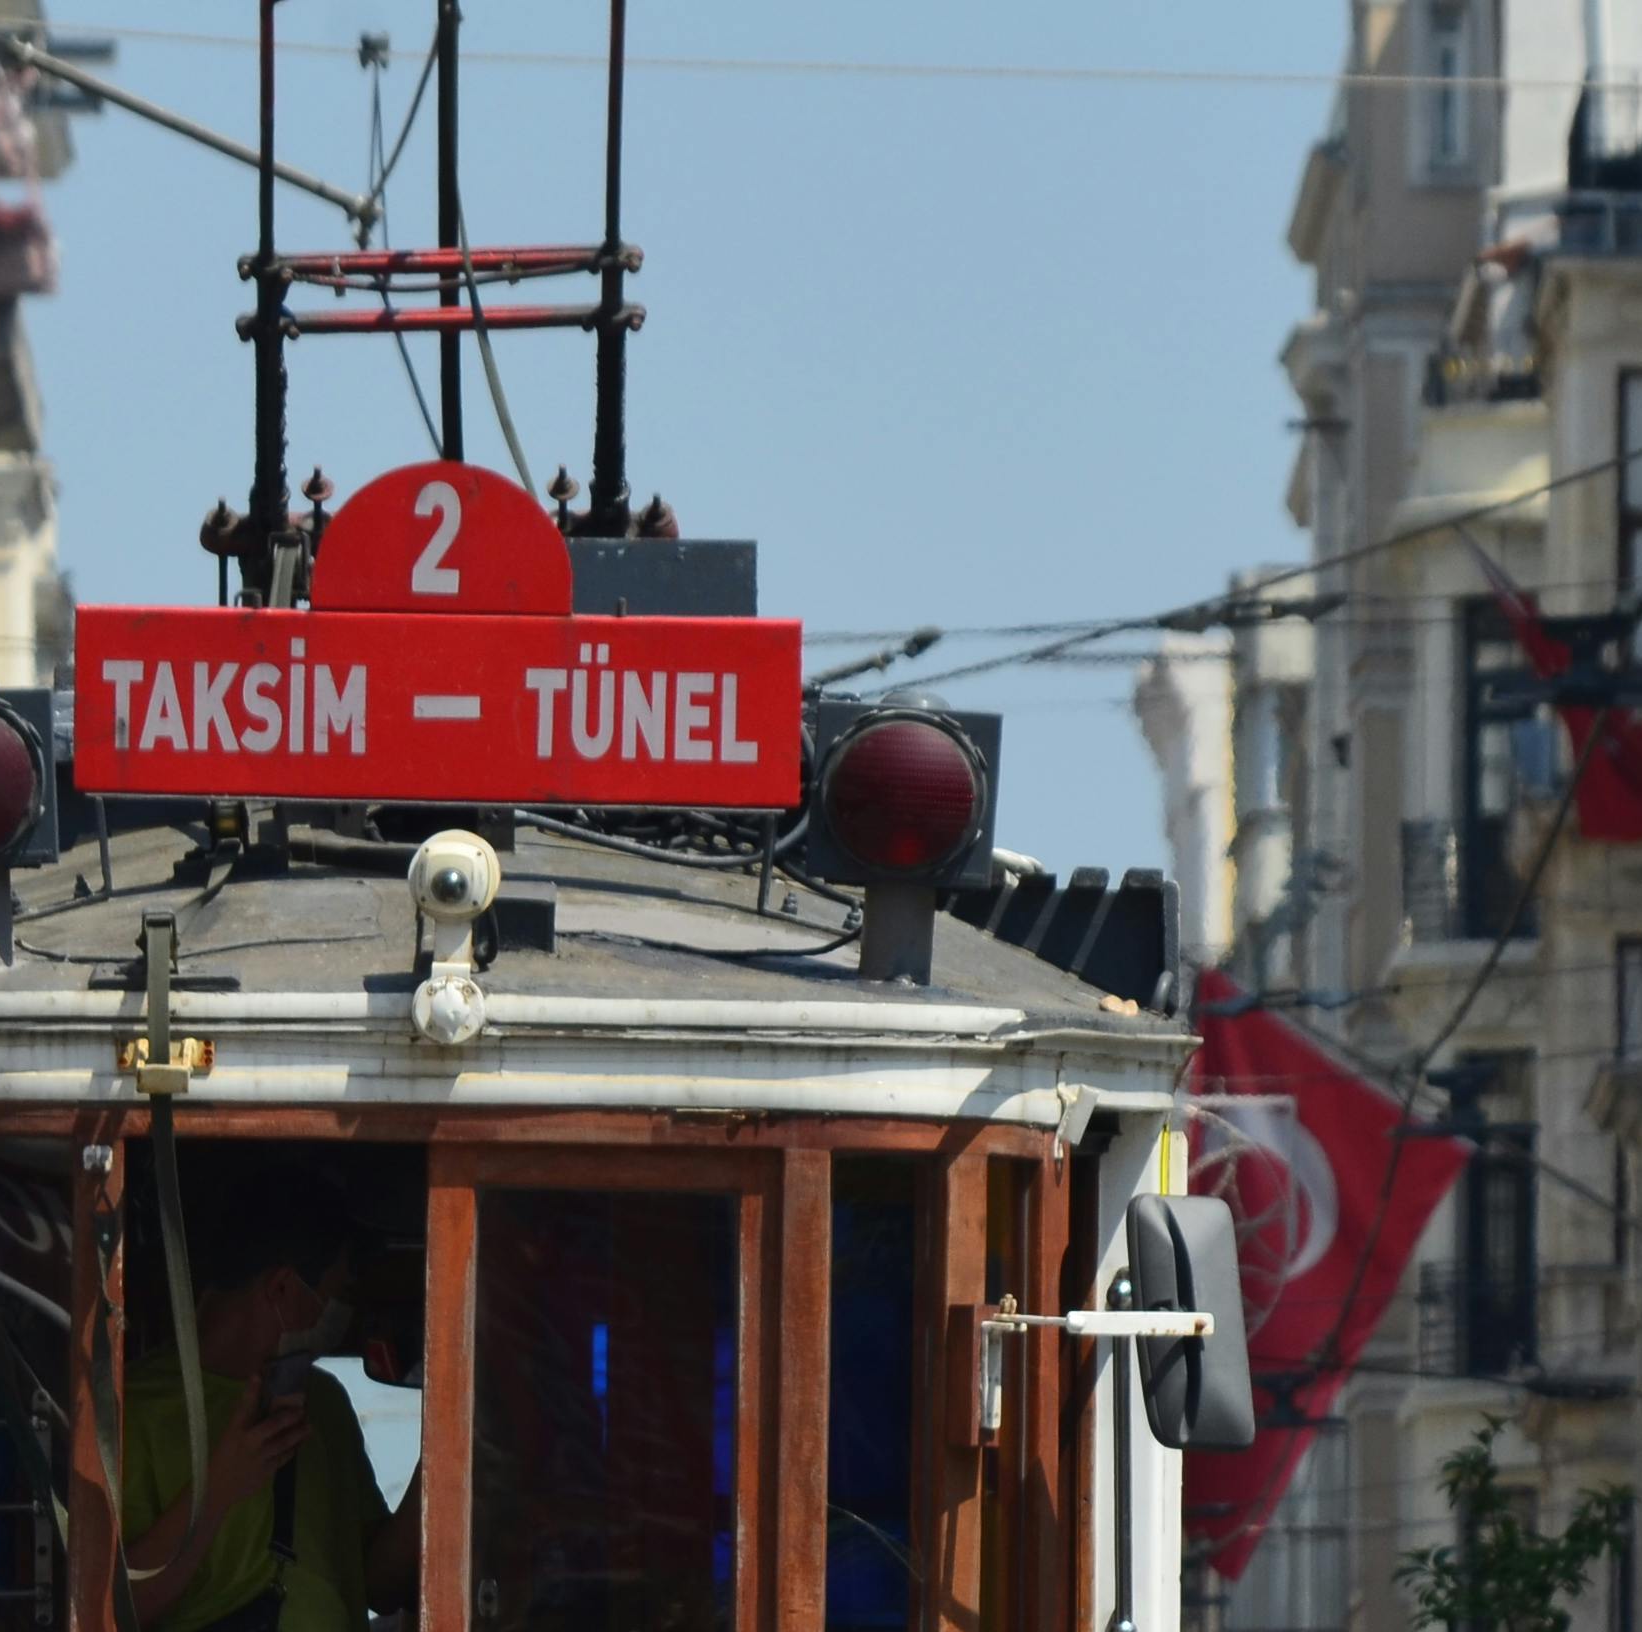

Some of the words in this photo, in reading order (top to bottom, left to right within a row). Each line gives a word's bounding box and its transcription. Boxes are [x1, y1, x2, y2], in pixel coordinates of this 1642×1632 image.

[411, 480, 462, 596] 2
[102, 637, 368, 755] TAKSİM
[524, 642, 759, 764] TÜNEL
